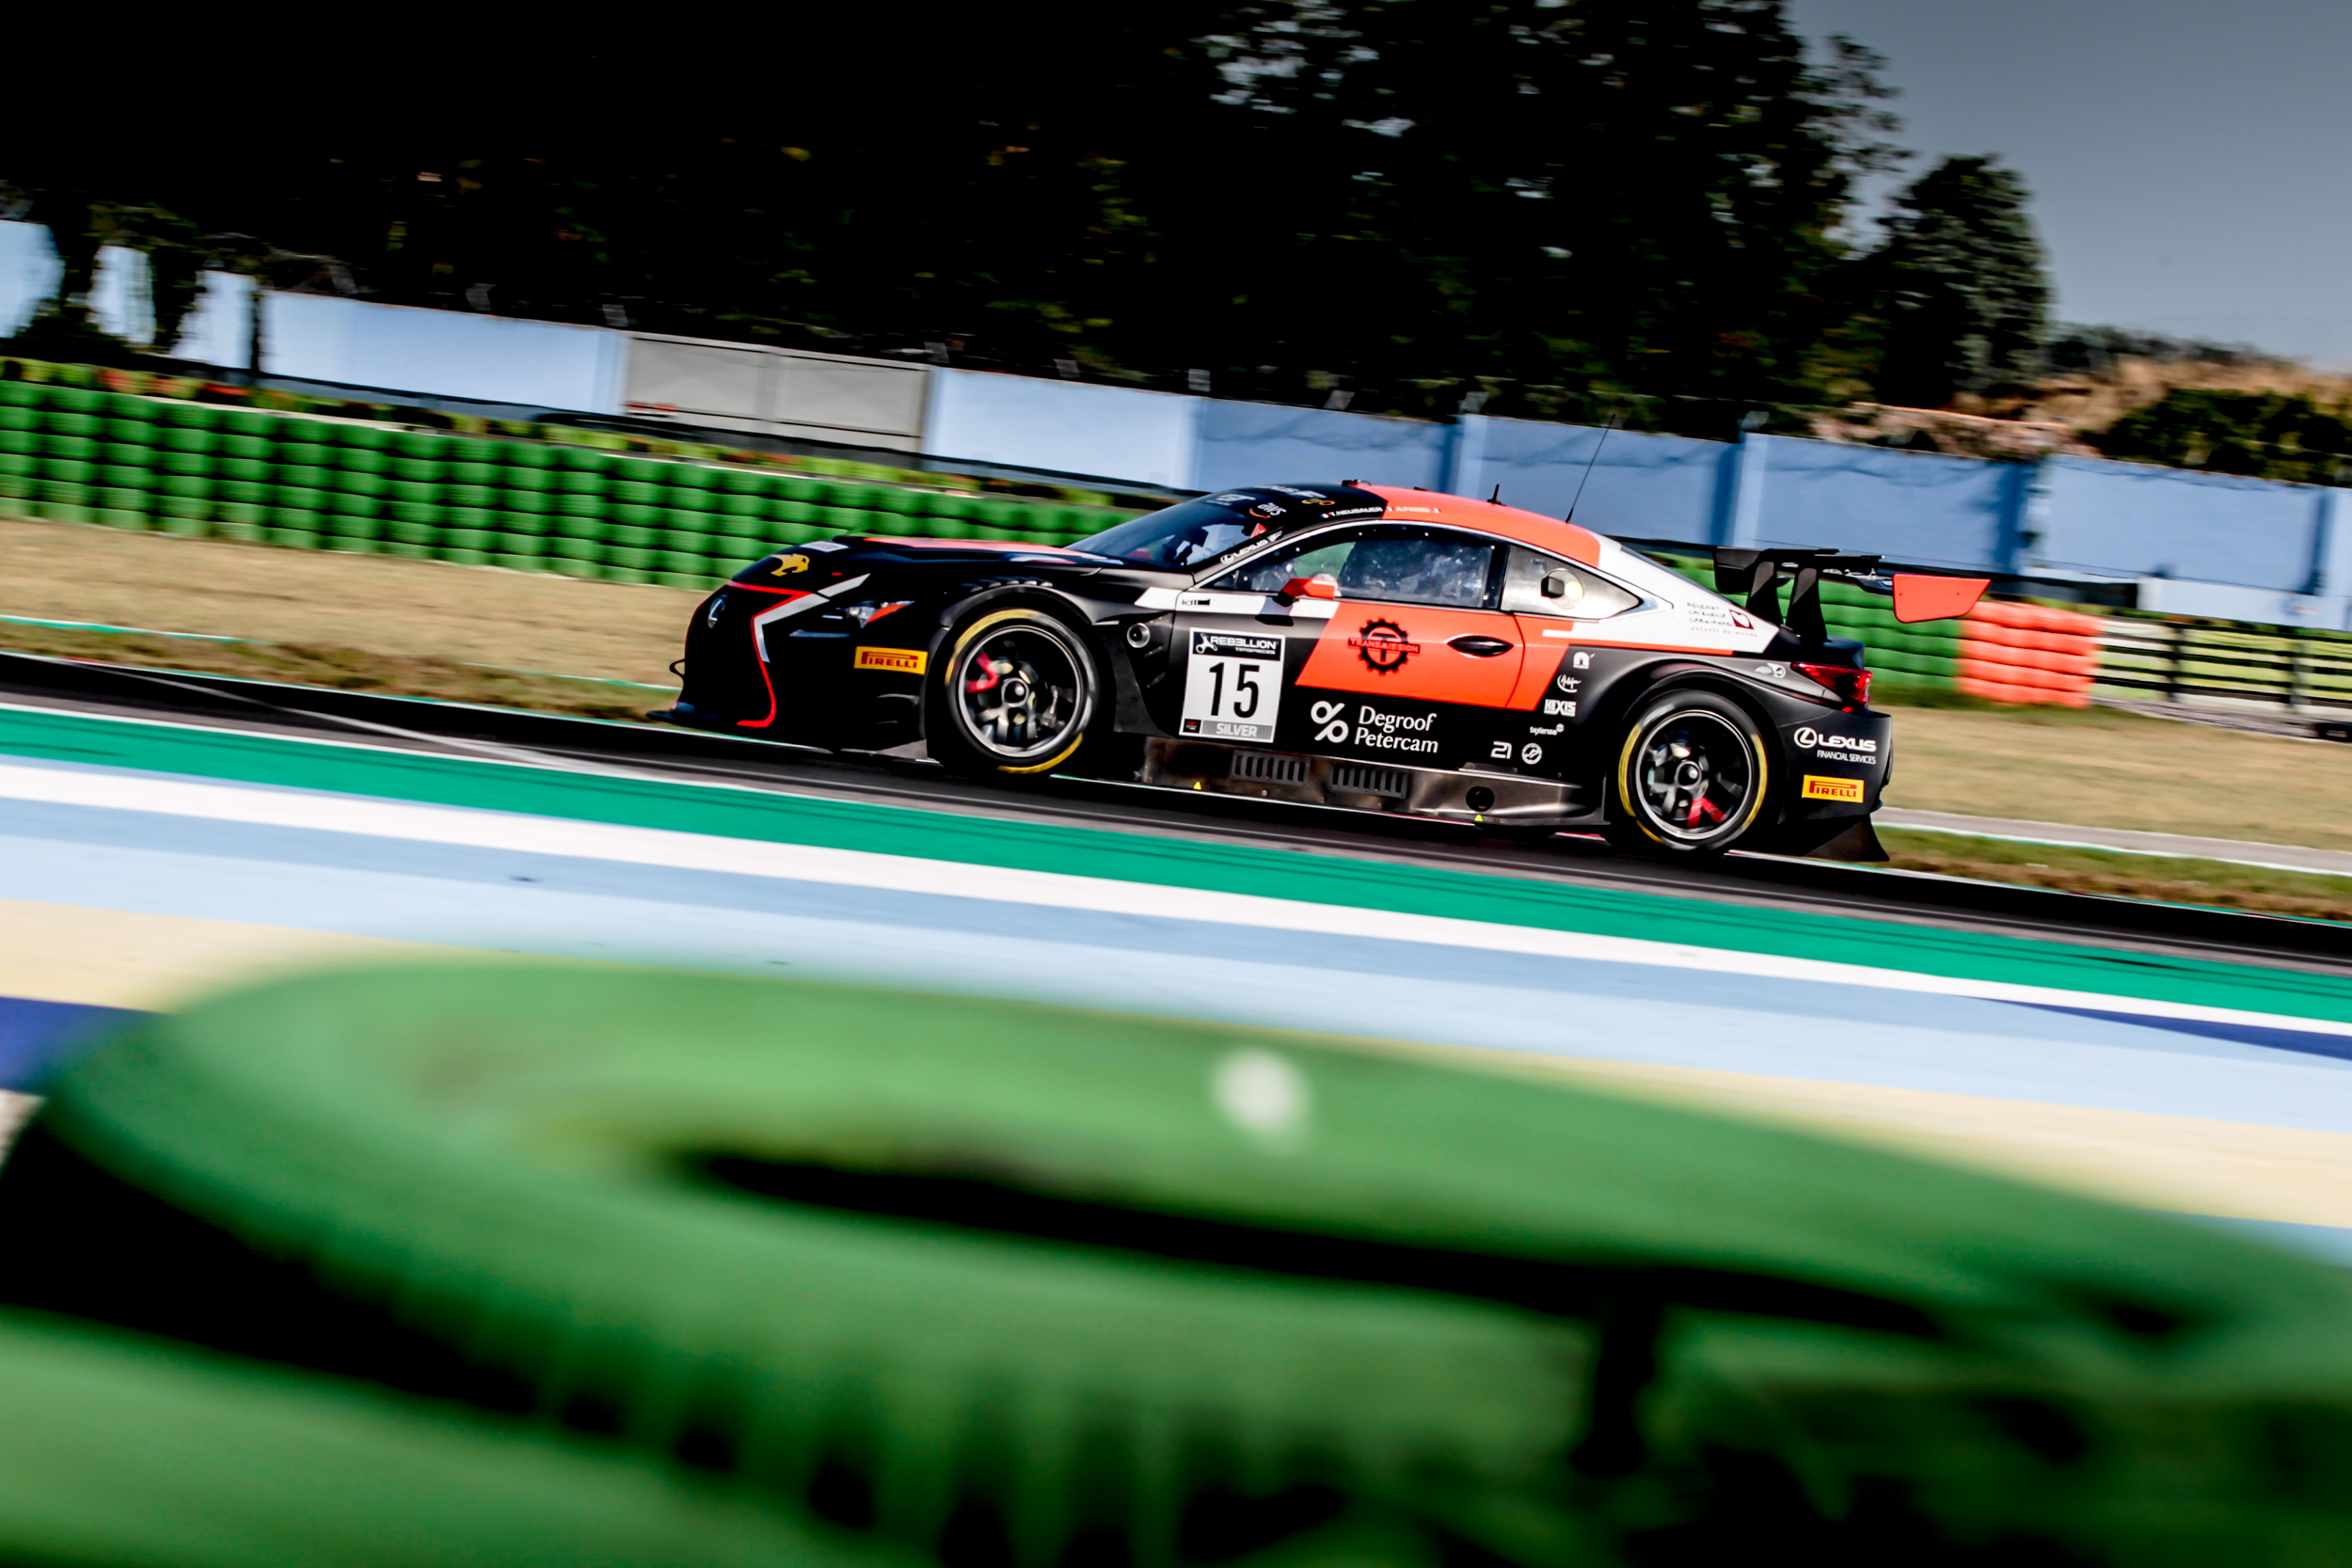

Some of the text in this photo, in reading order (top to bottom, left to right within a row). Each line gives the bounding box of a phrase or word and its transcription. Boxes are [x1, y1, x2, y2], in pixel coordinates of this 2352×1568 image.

[1257, 501, 1286, 516] aws
[1232, 539, 1269, 558] LEXUS
[1210, 635, 1277, 650] REBELLION
[861, 651, 918, 669] PIRELLI
[1209, 661, 1260, 719] 15
[1544, 699, 1577, 718] HEXIS
[1358, 705, 1438, 734] Degroof
[1216, 722, 1258, 737] SILVER
[1354, 726, 1439, 753] Petercam
[1818, 734, 1877, 752] LEXUS
[1817, 750, 1877, 765] FINANCIAL SERVICES
[1808, 780, 1857, 798] PIRELLI
